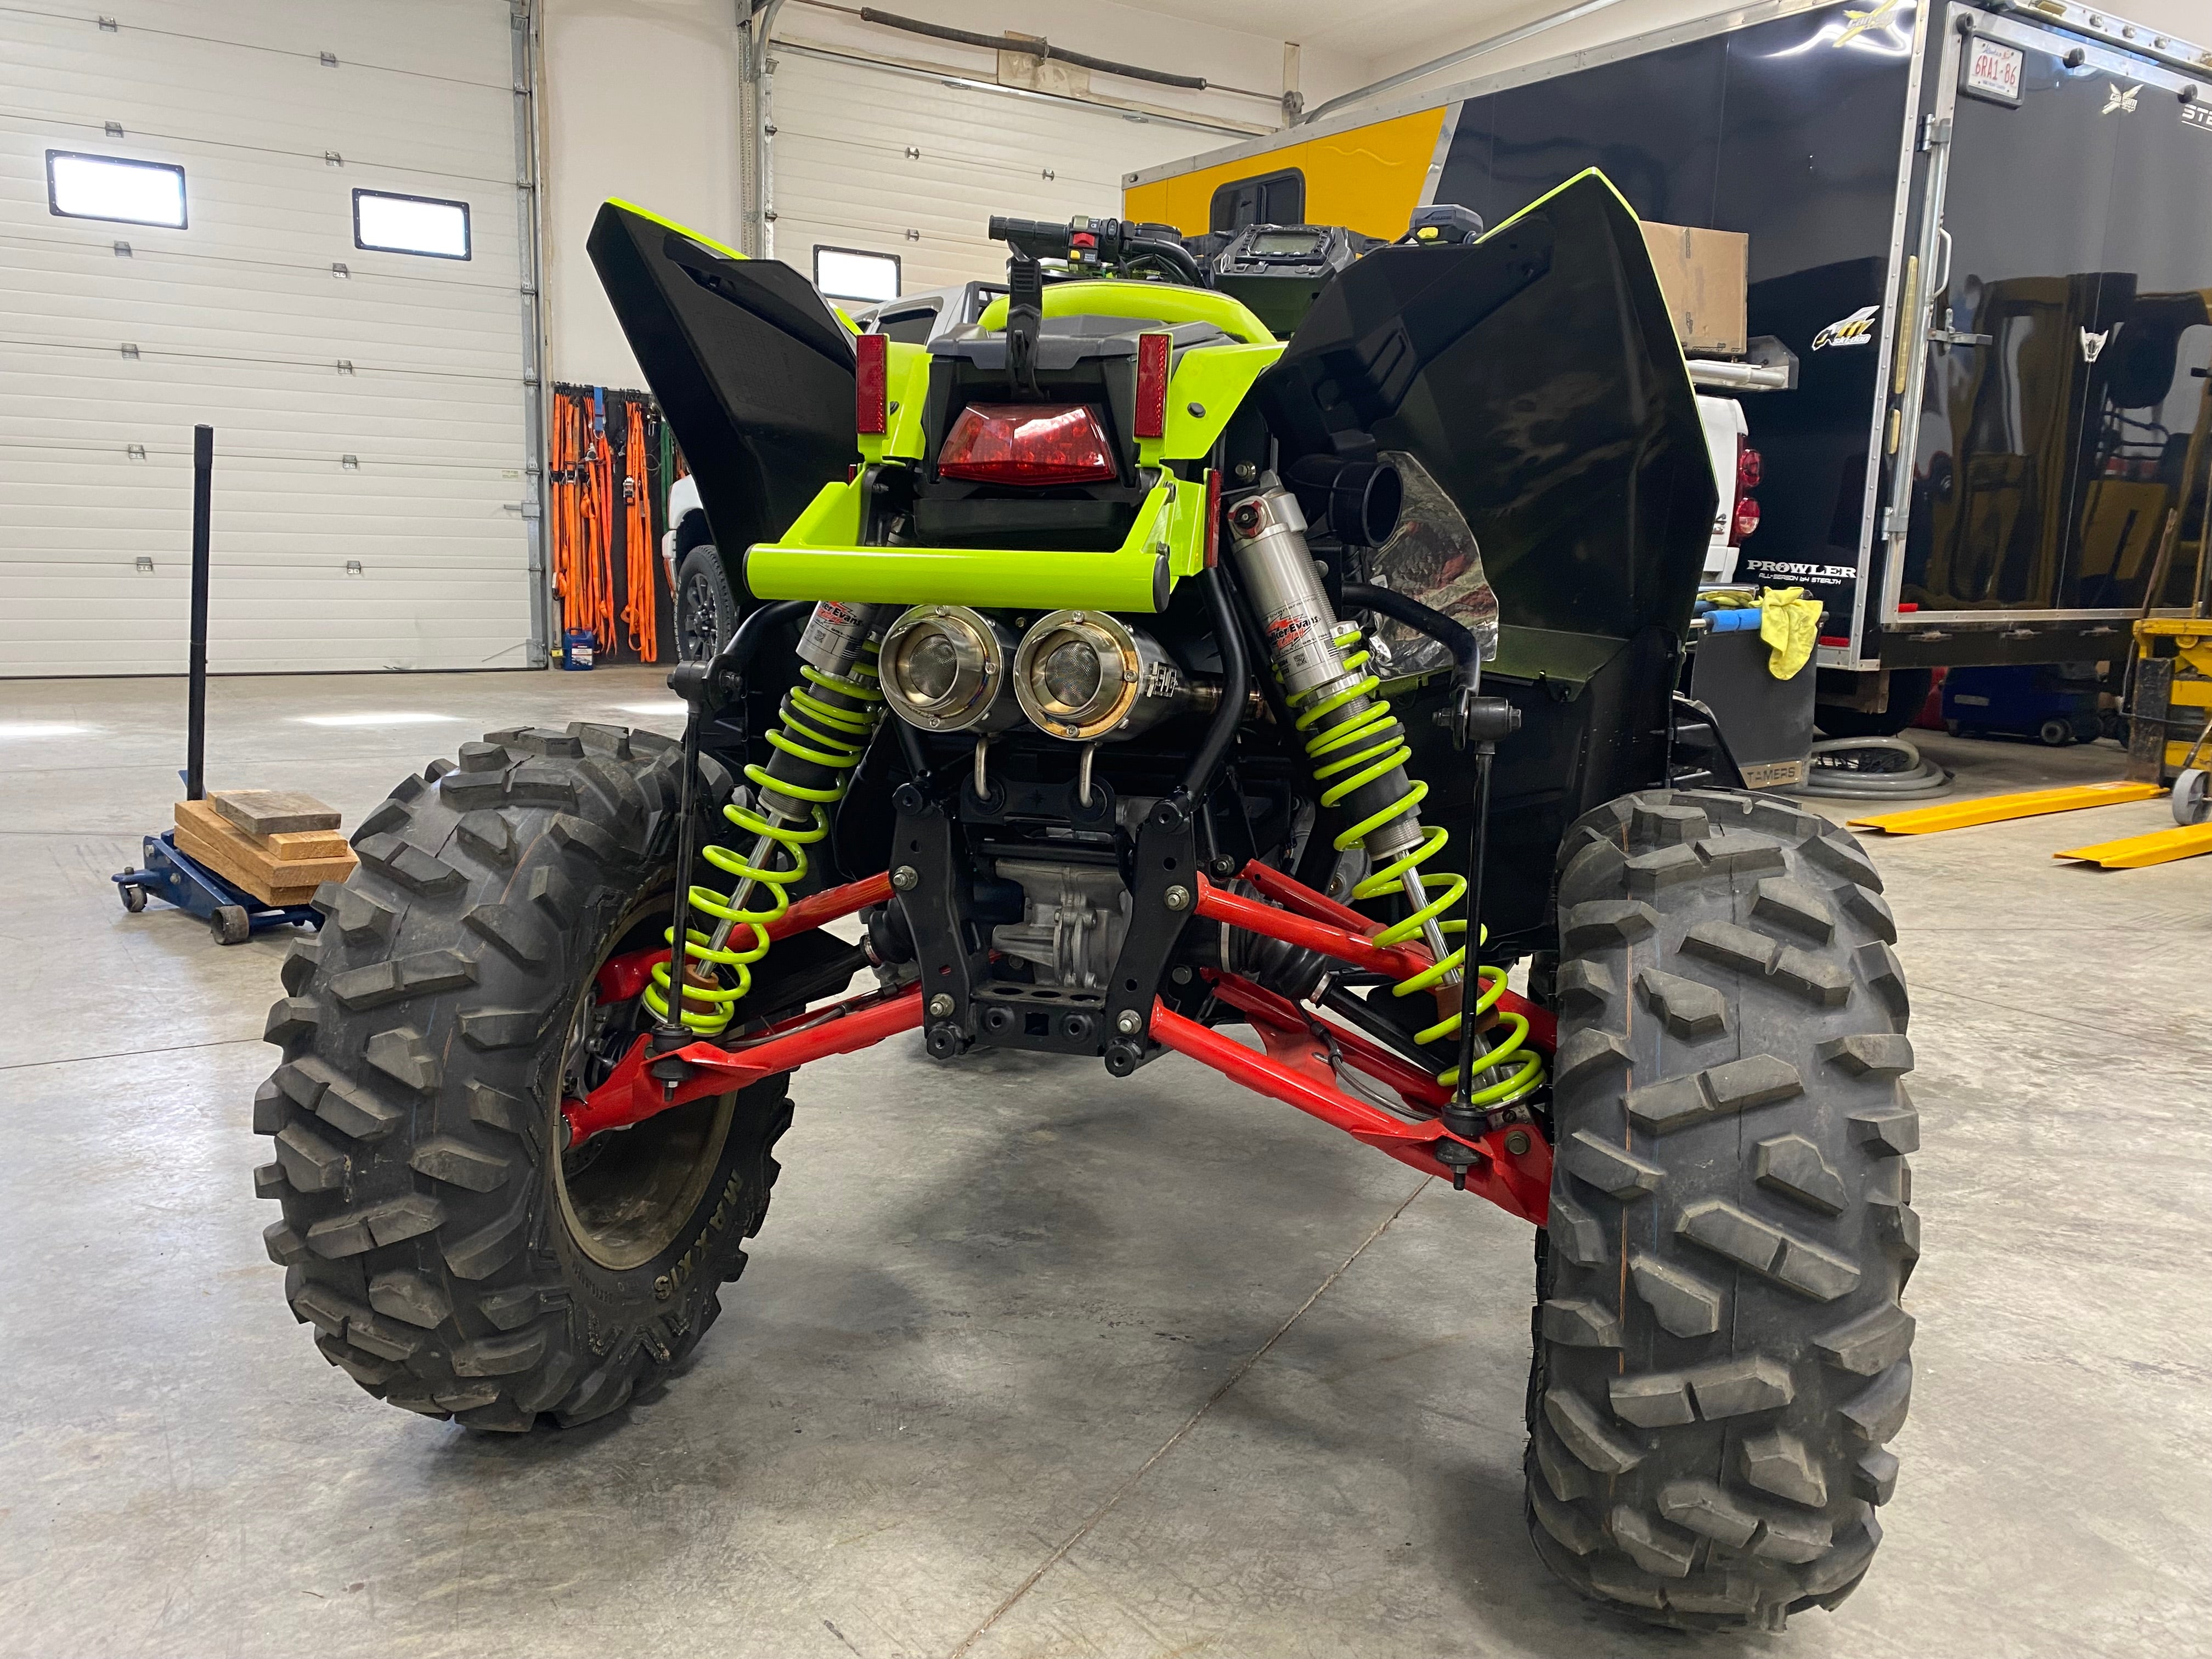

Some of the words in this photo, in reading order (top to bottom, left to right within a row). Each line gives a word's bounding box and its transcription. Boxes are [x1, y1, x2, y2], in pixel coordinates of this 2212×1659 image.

[1747, 559, 1857, 579] PROWLER
[1811, 577, 1842, 585] STEALTH
[832, 607, 864, 627] Evans
[1289, 616, 1319, 632] Evans
[1746, 766, 1796, 783] TAMERS
[653, 1168, 744, 1300] MAXXIS
